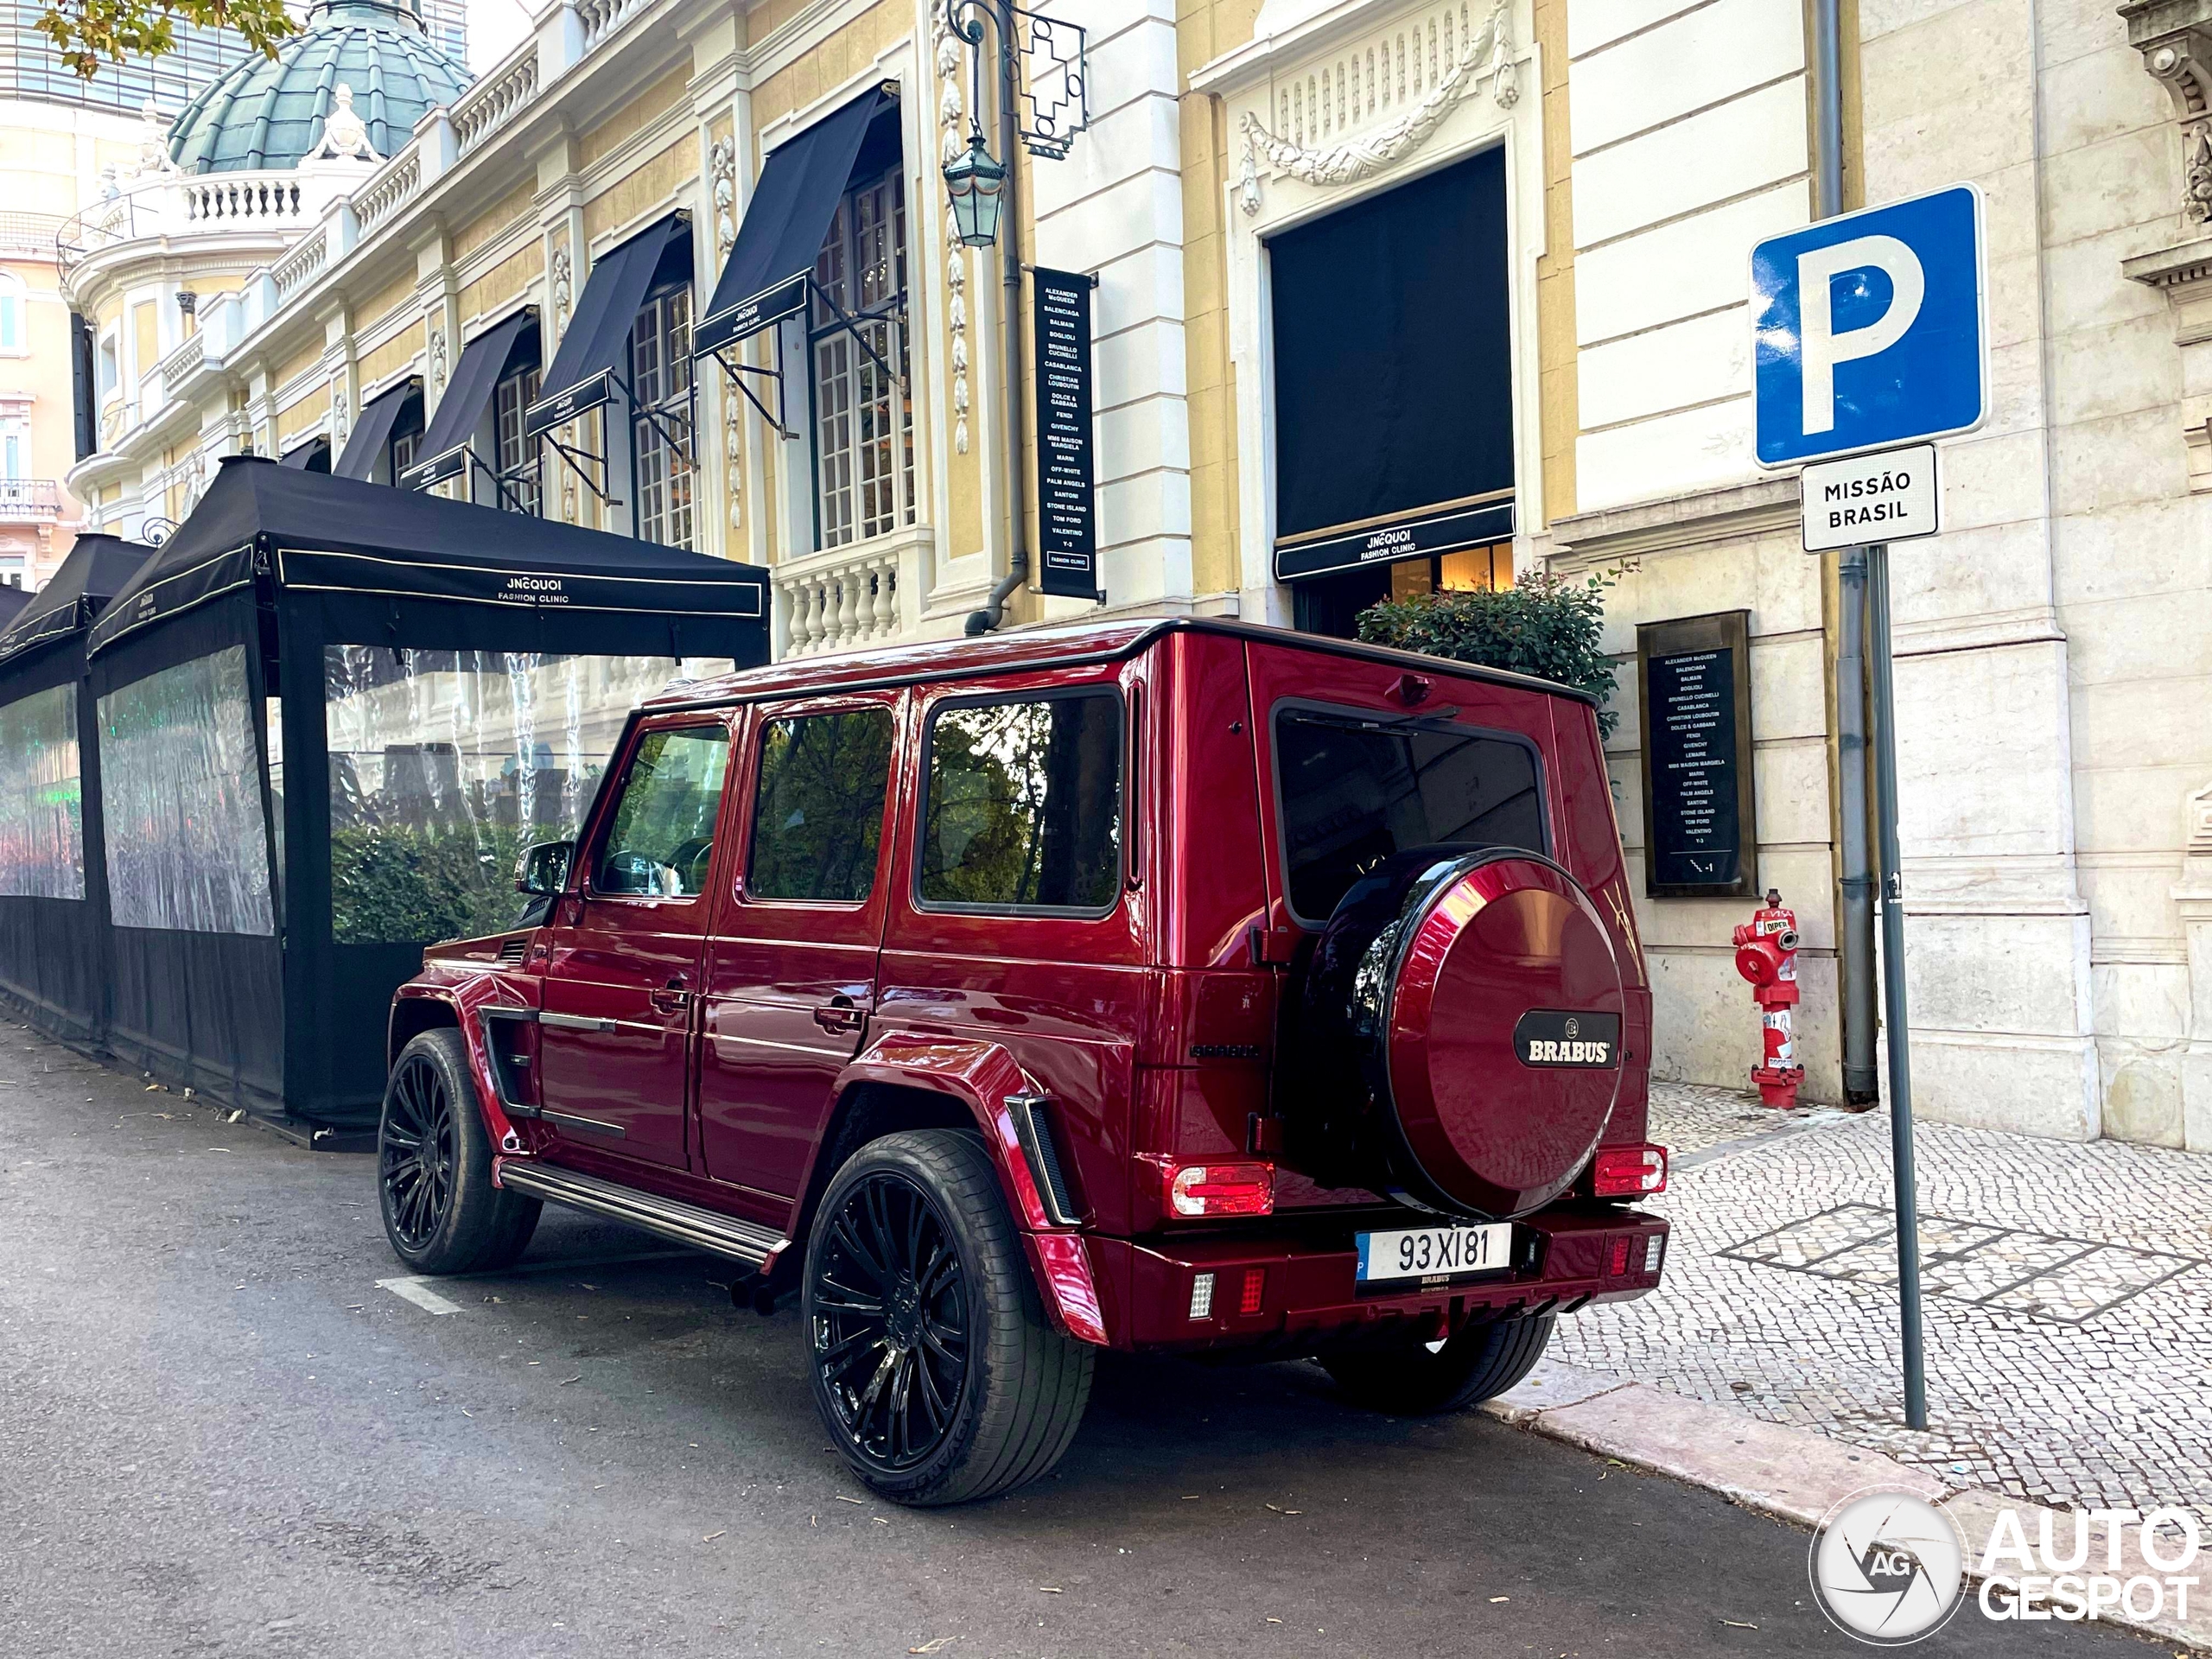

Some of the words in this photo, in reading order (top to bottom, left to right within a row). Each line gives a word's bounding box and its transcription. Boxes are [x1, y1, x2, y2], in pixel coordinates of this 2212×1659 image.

[1046, 288, 1077, 299] ALEXANDER
[1044, 306, 1079, 317] BALENCIAGA
[1050, 319, 1074, 328] BALMAIN
[1049, 332, 1075, 340] BOGLIOLI
[1797, 235, 1924, 435] P
[1048, 343, 1077, 353] BRUNELLO
[1049, 350, 1077, 359] CUCINELLI
[1045, 361, 1082, 372] CASABLANCA
[1049, 374, 1078, 384] CHRISTIAN
[1048, 380, 1079, 390] LOUBOUTIN
[1051, 399, 1077, 408] GABBANA
[1051, 423, 1078, 432] GIVENCHY
[1052, 442, 1079, 450] MARGIELA
[1825, 471, 1910, 502] MISSÃO
[1829, 501, 1908, 528] BRASIL
[1361, 549, 1389, 561] FASHION
[1392, 543, 1415, 554] CLINIC
[499, 593, 536, 601] FASHION
[1676, 664, 1706, 673] BALENCIAGA
[1529, 1040, 1606, 1063] BRABUS
[1421, 1274, 1450, 1284] BRABUS
